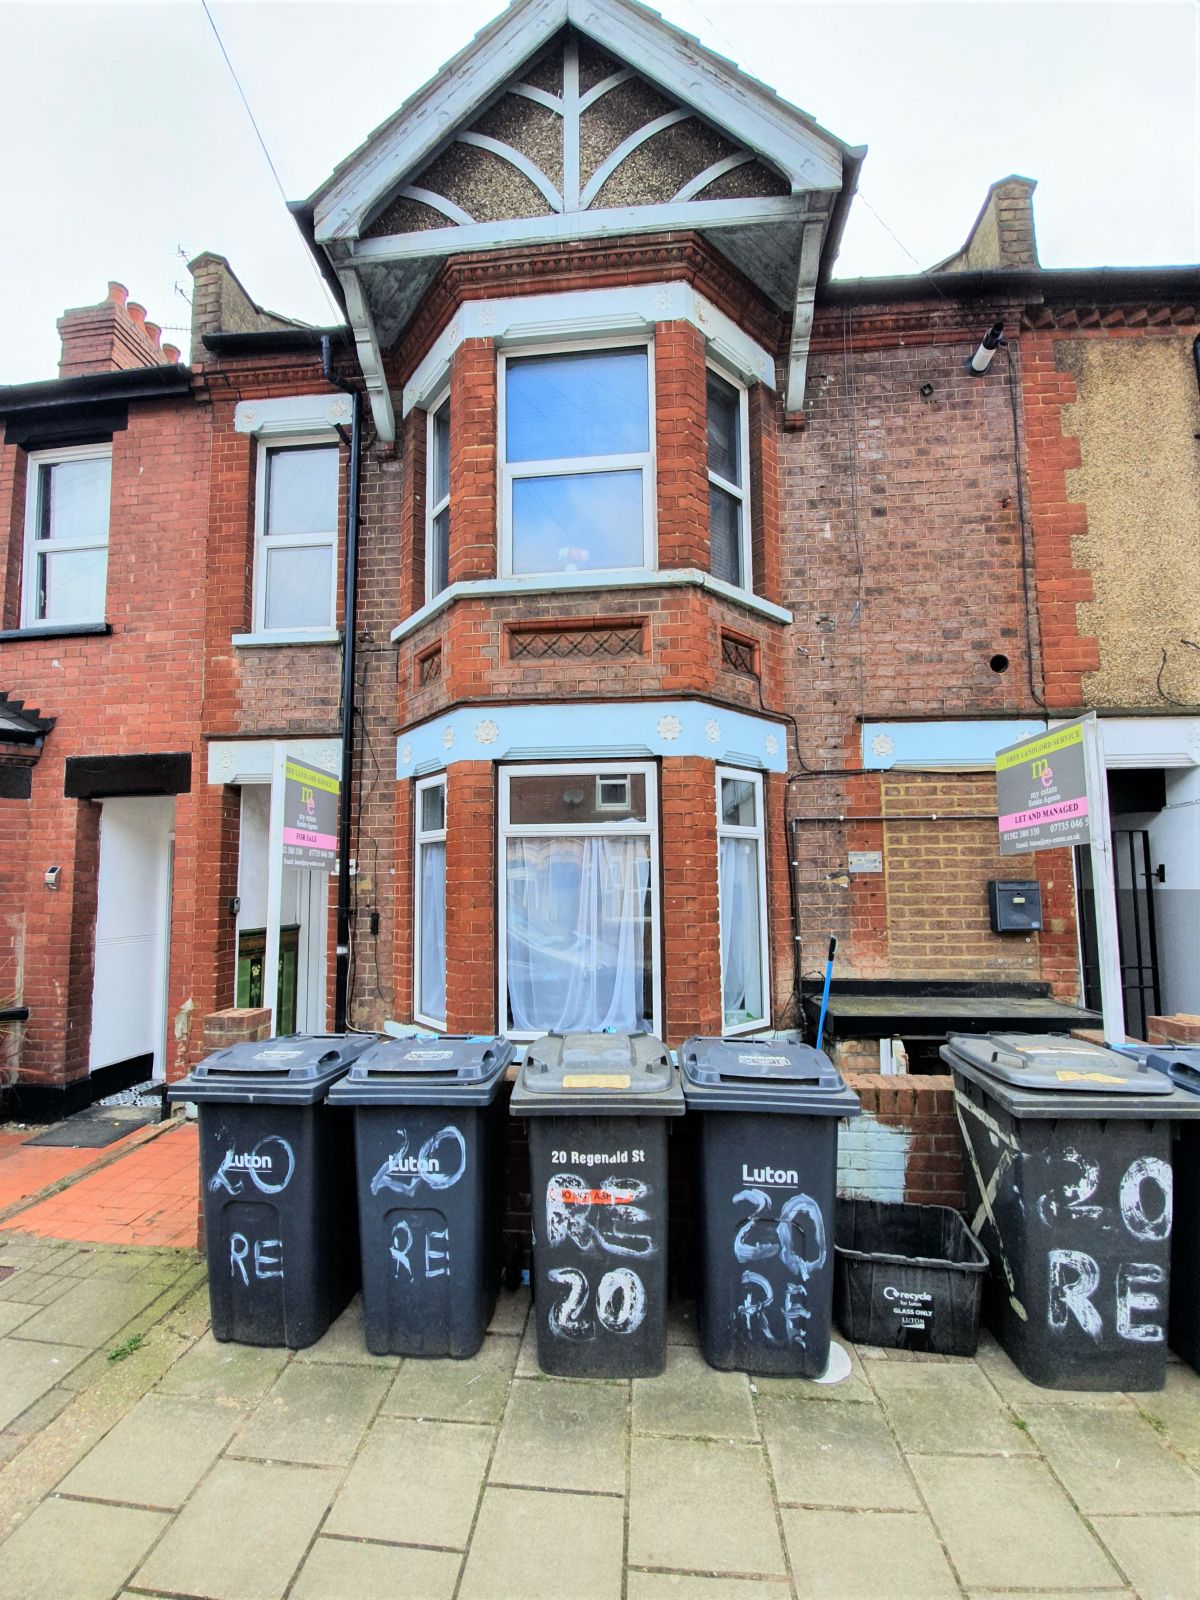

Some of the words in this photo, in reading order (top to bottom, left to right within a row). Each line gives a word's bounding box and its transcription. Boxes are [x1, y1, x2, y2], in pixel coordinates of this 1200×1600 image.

[1006, 753, 1019, 764] FREE
[1020, 742, 1051, 758] LANDLORD
[1052, 731, 1081, 745] SERVICE
[1031, 791, 1039, 799] my
[1041, 786, 1058, 795] estate
[1028, 798, 1042, 807] Estate
[1014, 814, 1027, 823] LET
[1028, 812, 1042, 820] AND
[1042, 802, 1079, 817] MANAGED
[1050, 822, 1069, 833] 07735
[1070, 819, 1083, 829] 046
[296, 833, 305, 841] FOR
[306, 834, 317, 843] SALE
[388, 1155, 440, 1173] Luton
[551, 1150, 567, 1164] 20
[632, 1149, 645, 1163] St
[742, 1164, 798, 1184] Luton
[230, 1232, 284, 1287] RE
[548, 1267, 647, 1341] 20
[901, 1292, 931, 1301] recycle
[1048, 1248, 1165, 1345] RE
